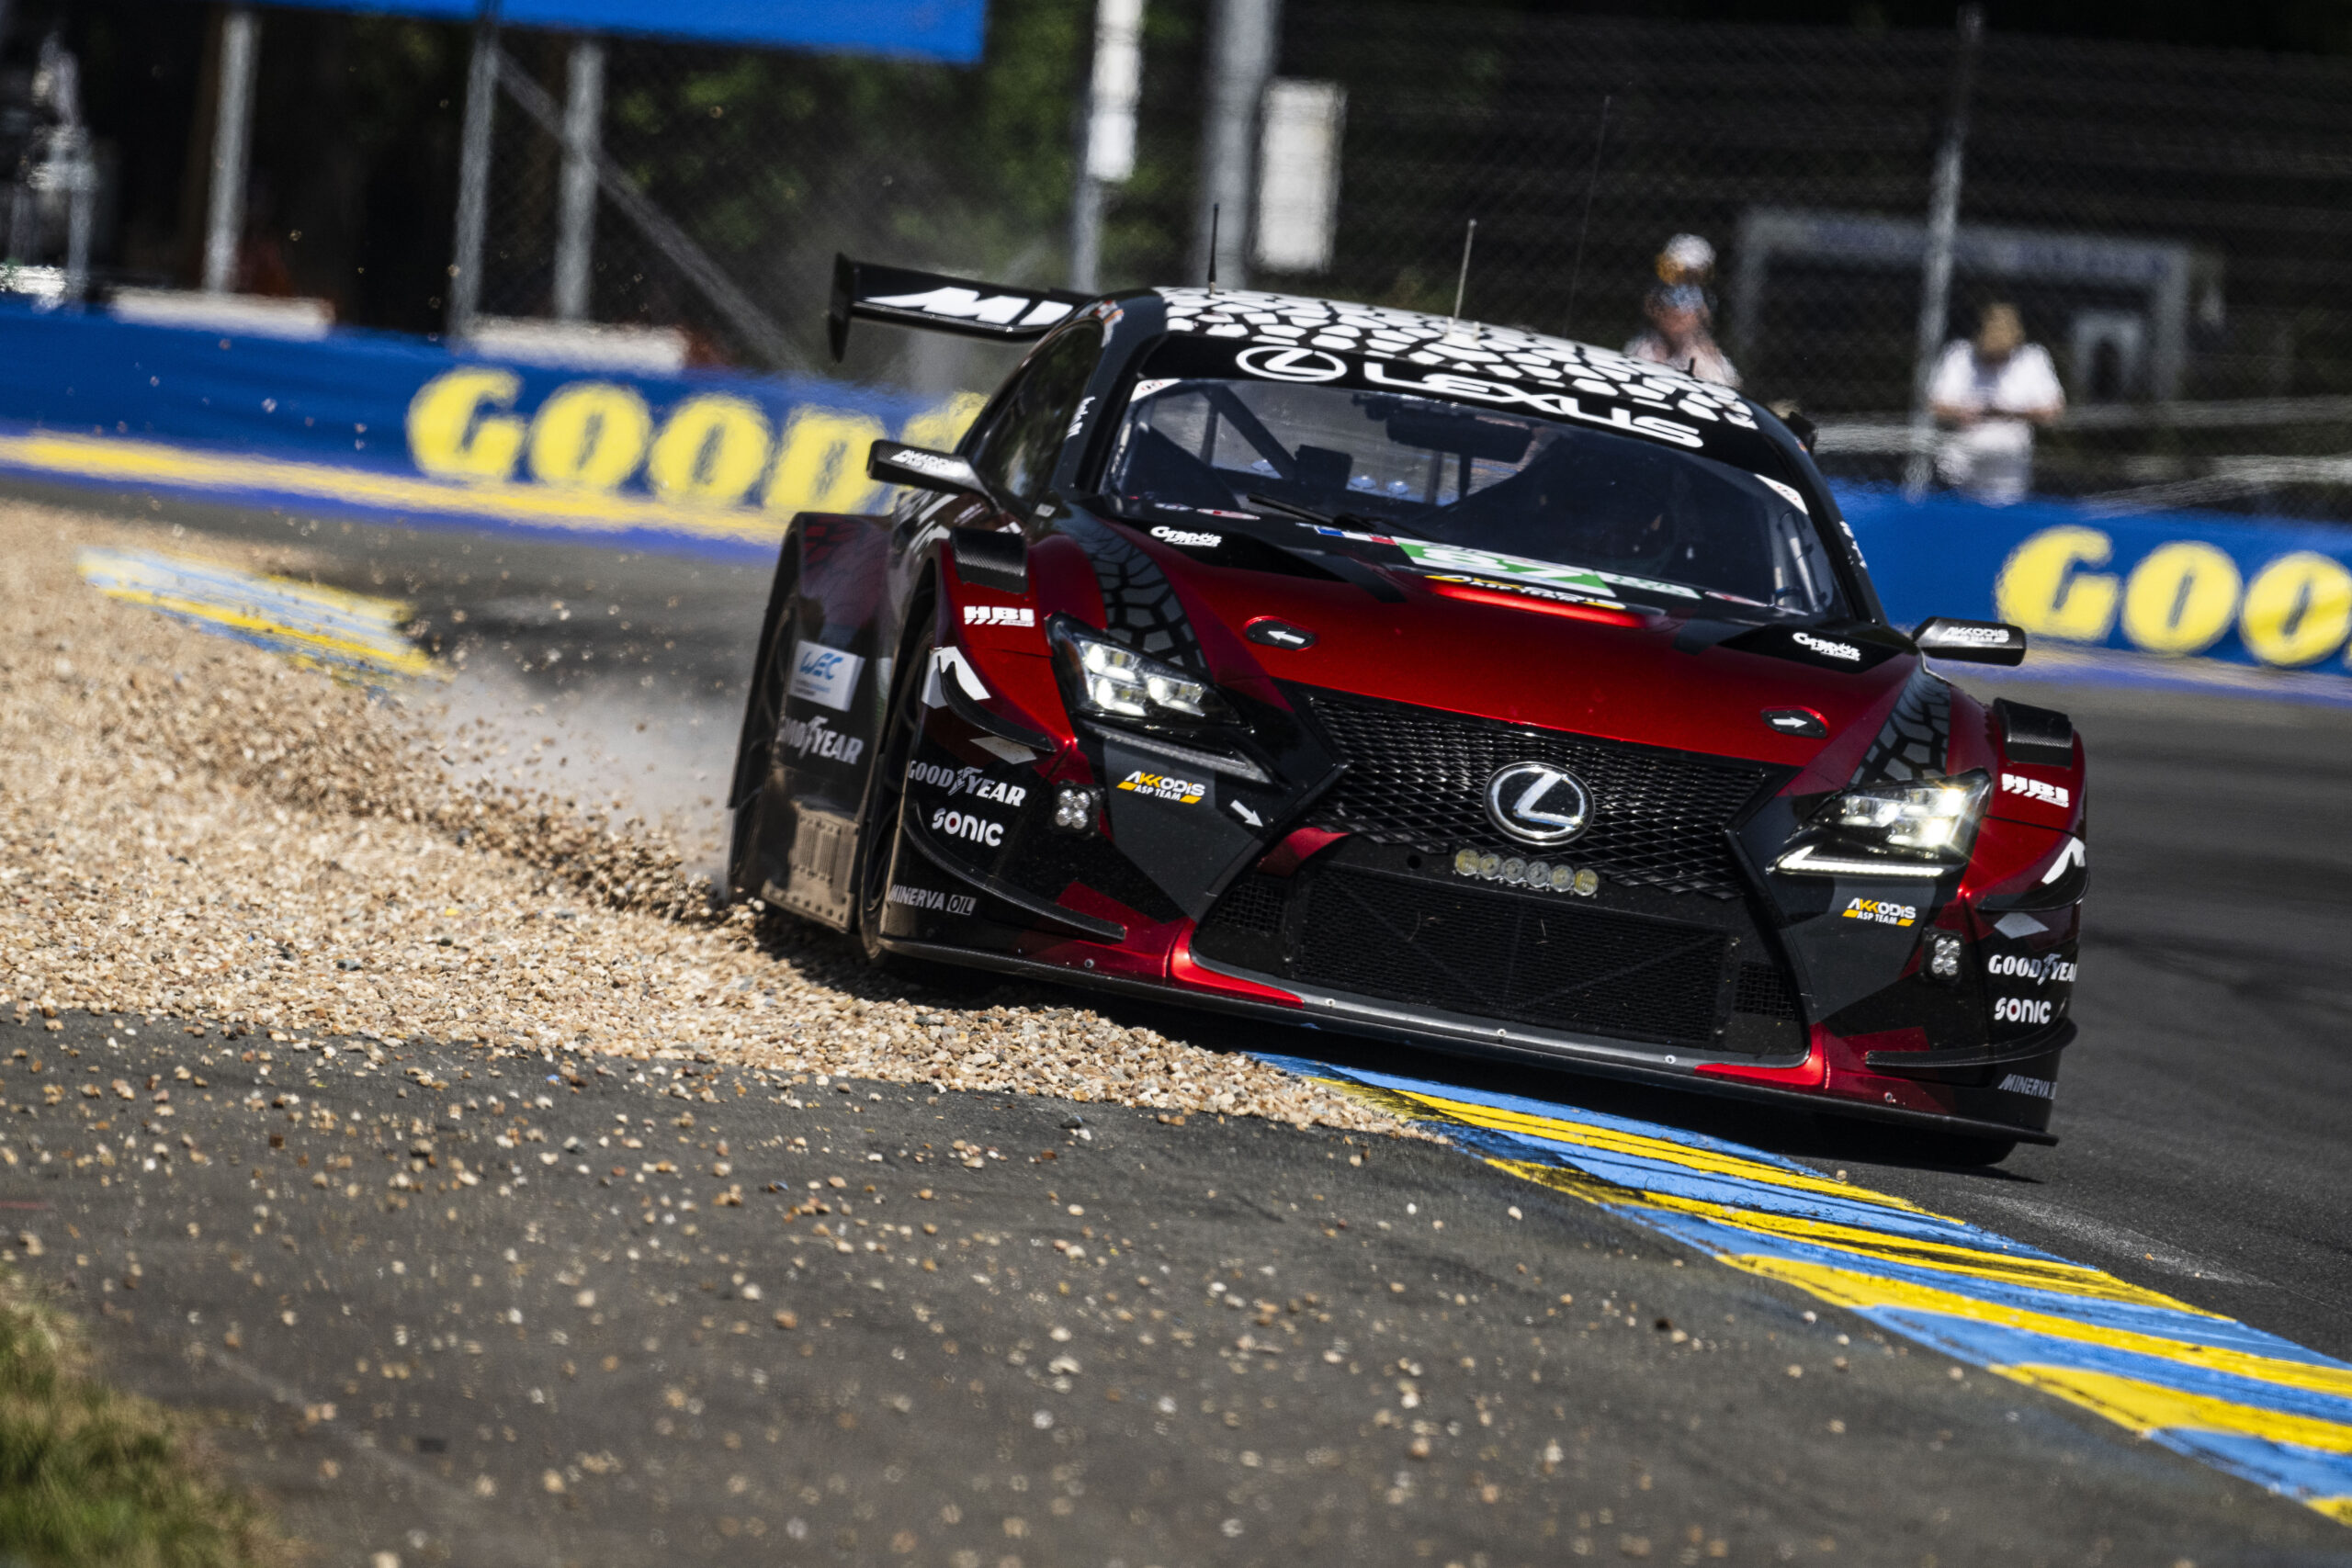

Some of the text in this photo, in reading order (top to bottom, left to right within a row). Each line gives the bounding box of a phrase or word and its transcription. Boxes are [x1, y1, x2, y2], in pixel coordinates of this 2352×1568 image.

[1364, 362, 1704, 448] LEXUS
[1422, 547, 1583, 580] 87
[1995, 525, 2352, 669] GOO
[907, 760, 1027, 807] GOODYEAR
[1134, 784, 1182, 802] ASP TEAM
[888, 884, 975, 915] MINERVA OIL
[1857, 910, 1898, 925] ASP TEAM
[1988, 953, 2077, 986] GOODYEA
[1997, 1073, 2051, 1100] MINERVA
